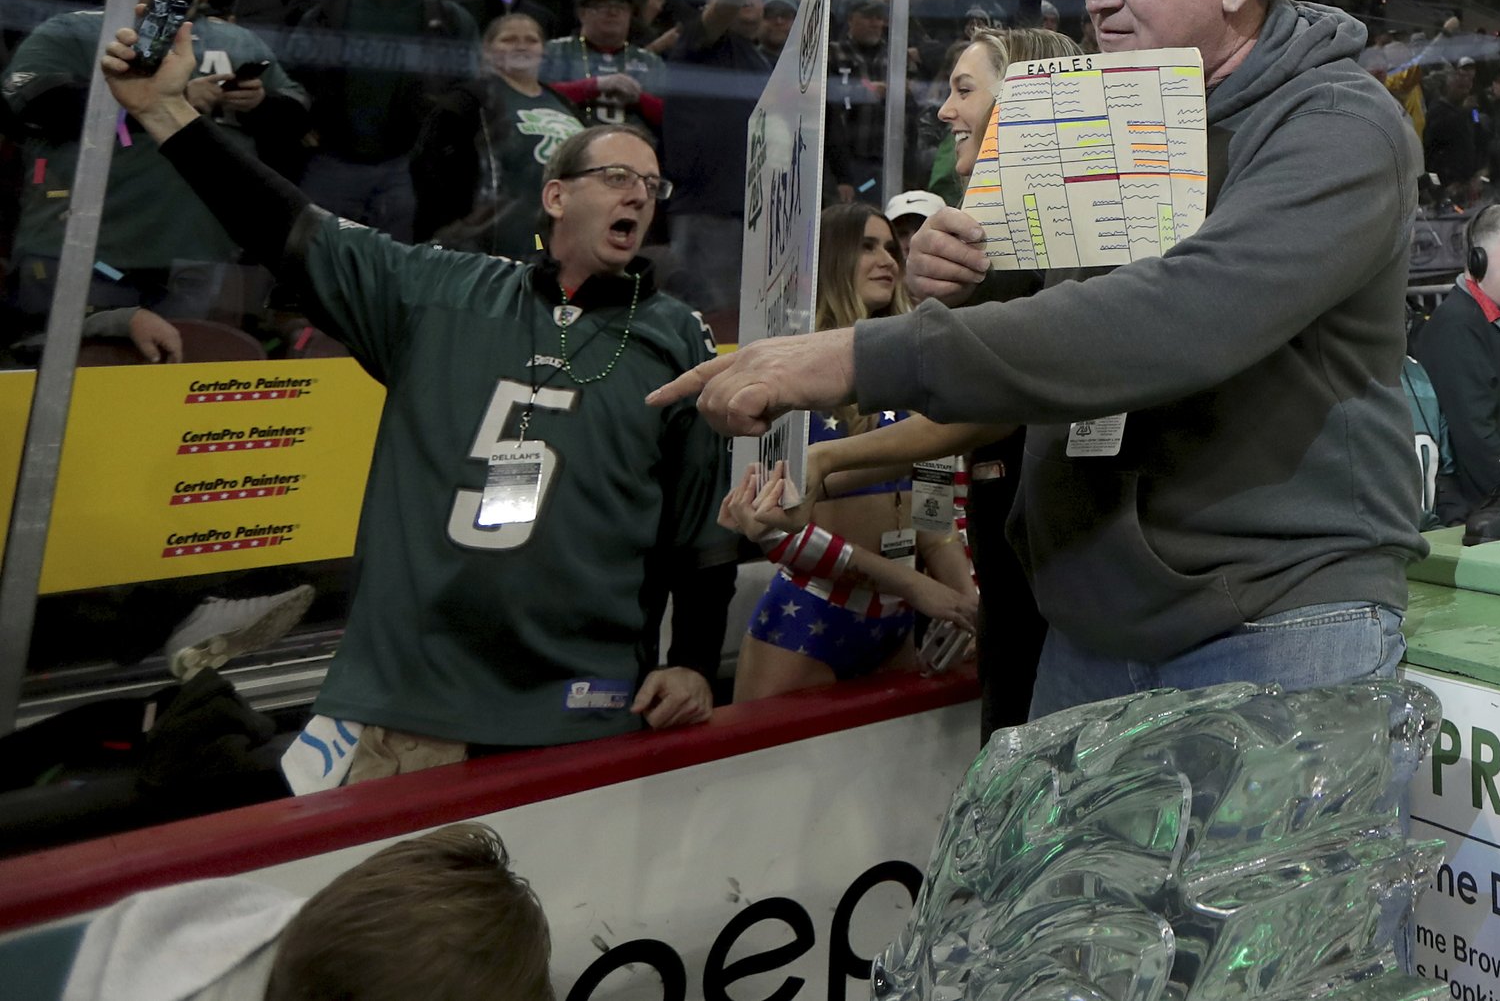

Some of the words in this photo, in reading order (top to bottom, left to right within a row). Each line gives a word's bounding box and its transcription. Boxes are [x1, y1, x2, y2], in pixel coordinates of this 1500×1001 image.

[1027, 57, 1093, 76] EAGLES
[189, 379, 251, 393] CertaPro
[256, 376, 312, 389] Painters
[182, 428, 245, 444] CertaPro
[249, 425, 305, 439] Painters
[448, 379, 578, 552] 5
[491, 452, 541, 462] DELILAH'S
[174, 478, 238, 494] CertaPro
[242, 474, 300, 487] Painters
[166, 529, 231, 546] CertaPro
[235, 523, 294, 539] Painters
[565, 860, 925, 1001] ep
